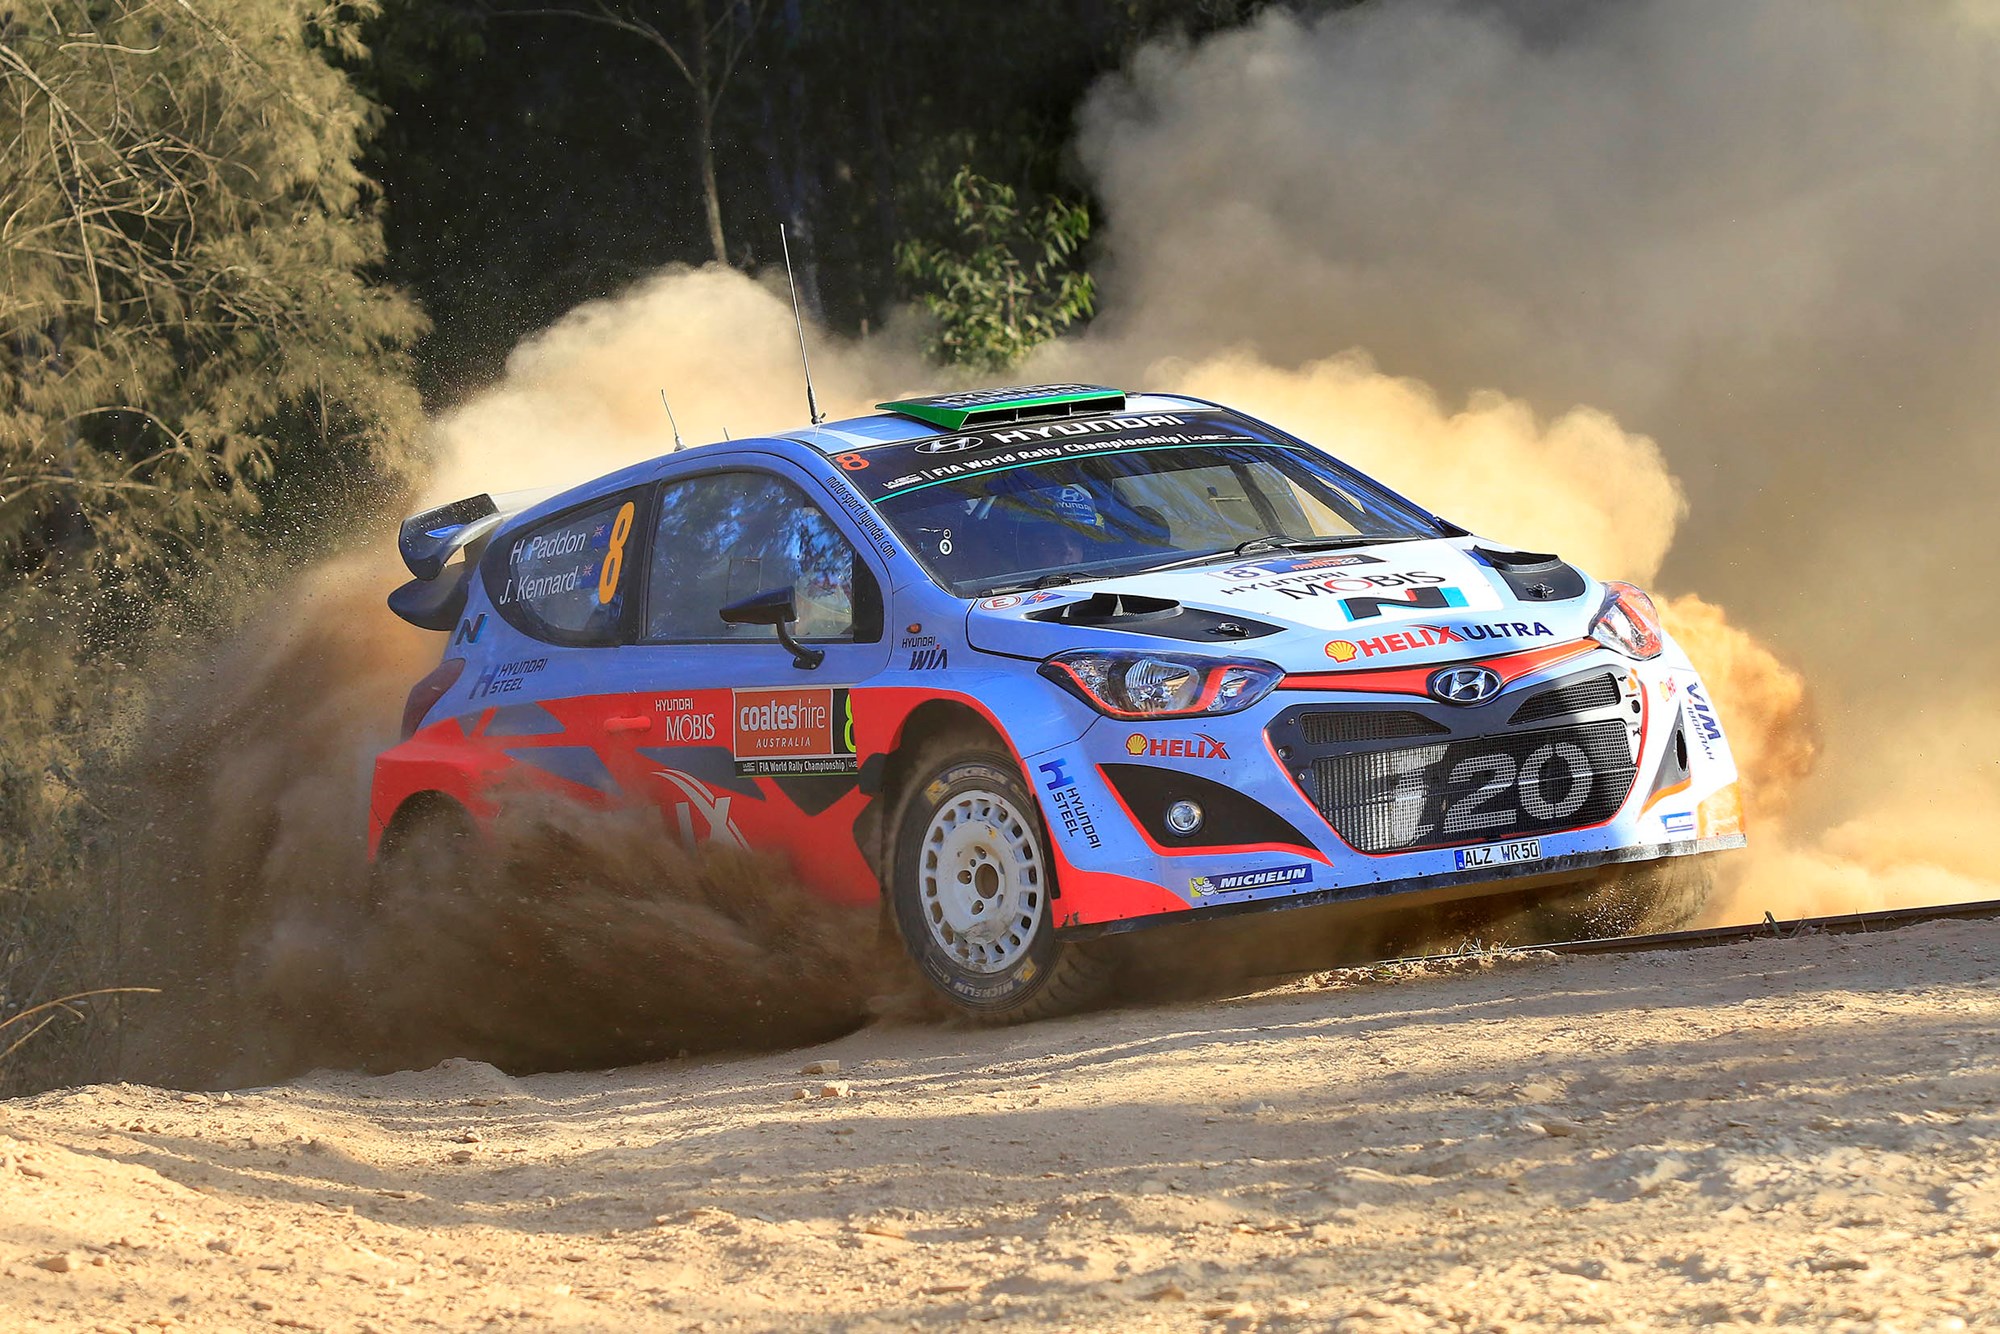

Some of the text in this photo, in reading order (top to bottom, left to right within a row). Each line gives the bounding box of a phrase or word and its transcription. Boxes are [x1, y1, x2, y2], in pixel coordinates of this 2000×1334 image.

[991, 415, 1186, 445] HYUNDAI
[836, 453, 870, 471] 8
[932, 464, 966, 477] FIA
[963, 453, 1017, 469] World
[1017, 443, 1062, 460] Rally
[1063, 434, 1181, 452] Championship
[826, 475, 897, 560] motorsport.hyundai.com
[509, 529, 587, 566] H. Paddon
[599, 501, 635, 605] 8
[499, 565, 579, 605] J. Kennard
[1221, 571, 1349, 595] HYUNDAI
[1275, 571, 1447, 601] MOBIS
[901, 636, 936, 649] HYUNDAI
[1356, 620, 1555, 658] HELIX ULTRA
[498, 658, 549, 678] HYUNDAI
[908, 645, 948, 671] WIA
[489, 677, 524, 695] STEEL
[655, 697, 694, 712] HYUNDAI
[740, 698, 826, 732] coateshire
[666, 713, 716, 743] MOBIS
[755, 737, 812, 749] AUSTRALIA
[1149, 732, 1231, 760] HELIX
[759, 761, 770, 773] FIA
[769, 761, 788, 772] World
[788, 761, 804, 773] Rally
[804, 759, 845, 773] Championship
[1052, 791, 1079, 838] STEEL
[1066, 787, 1102, 849] HYUNDAI
[1465, 847, 1493, 868] ALZ
[1220, 867, 1307, 889] MICHELIN
